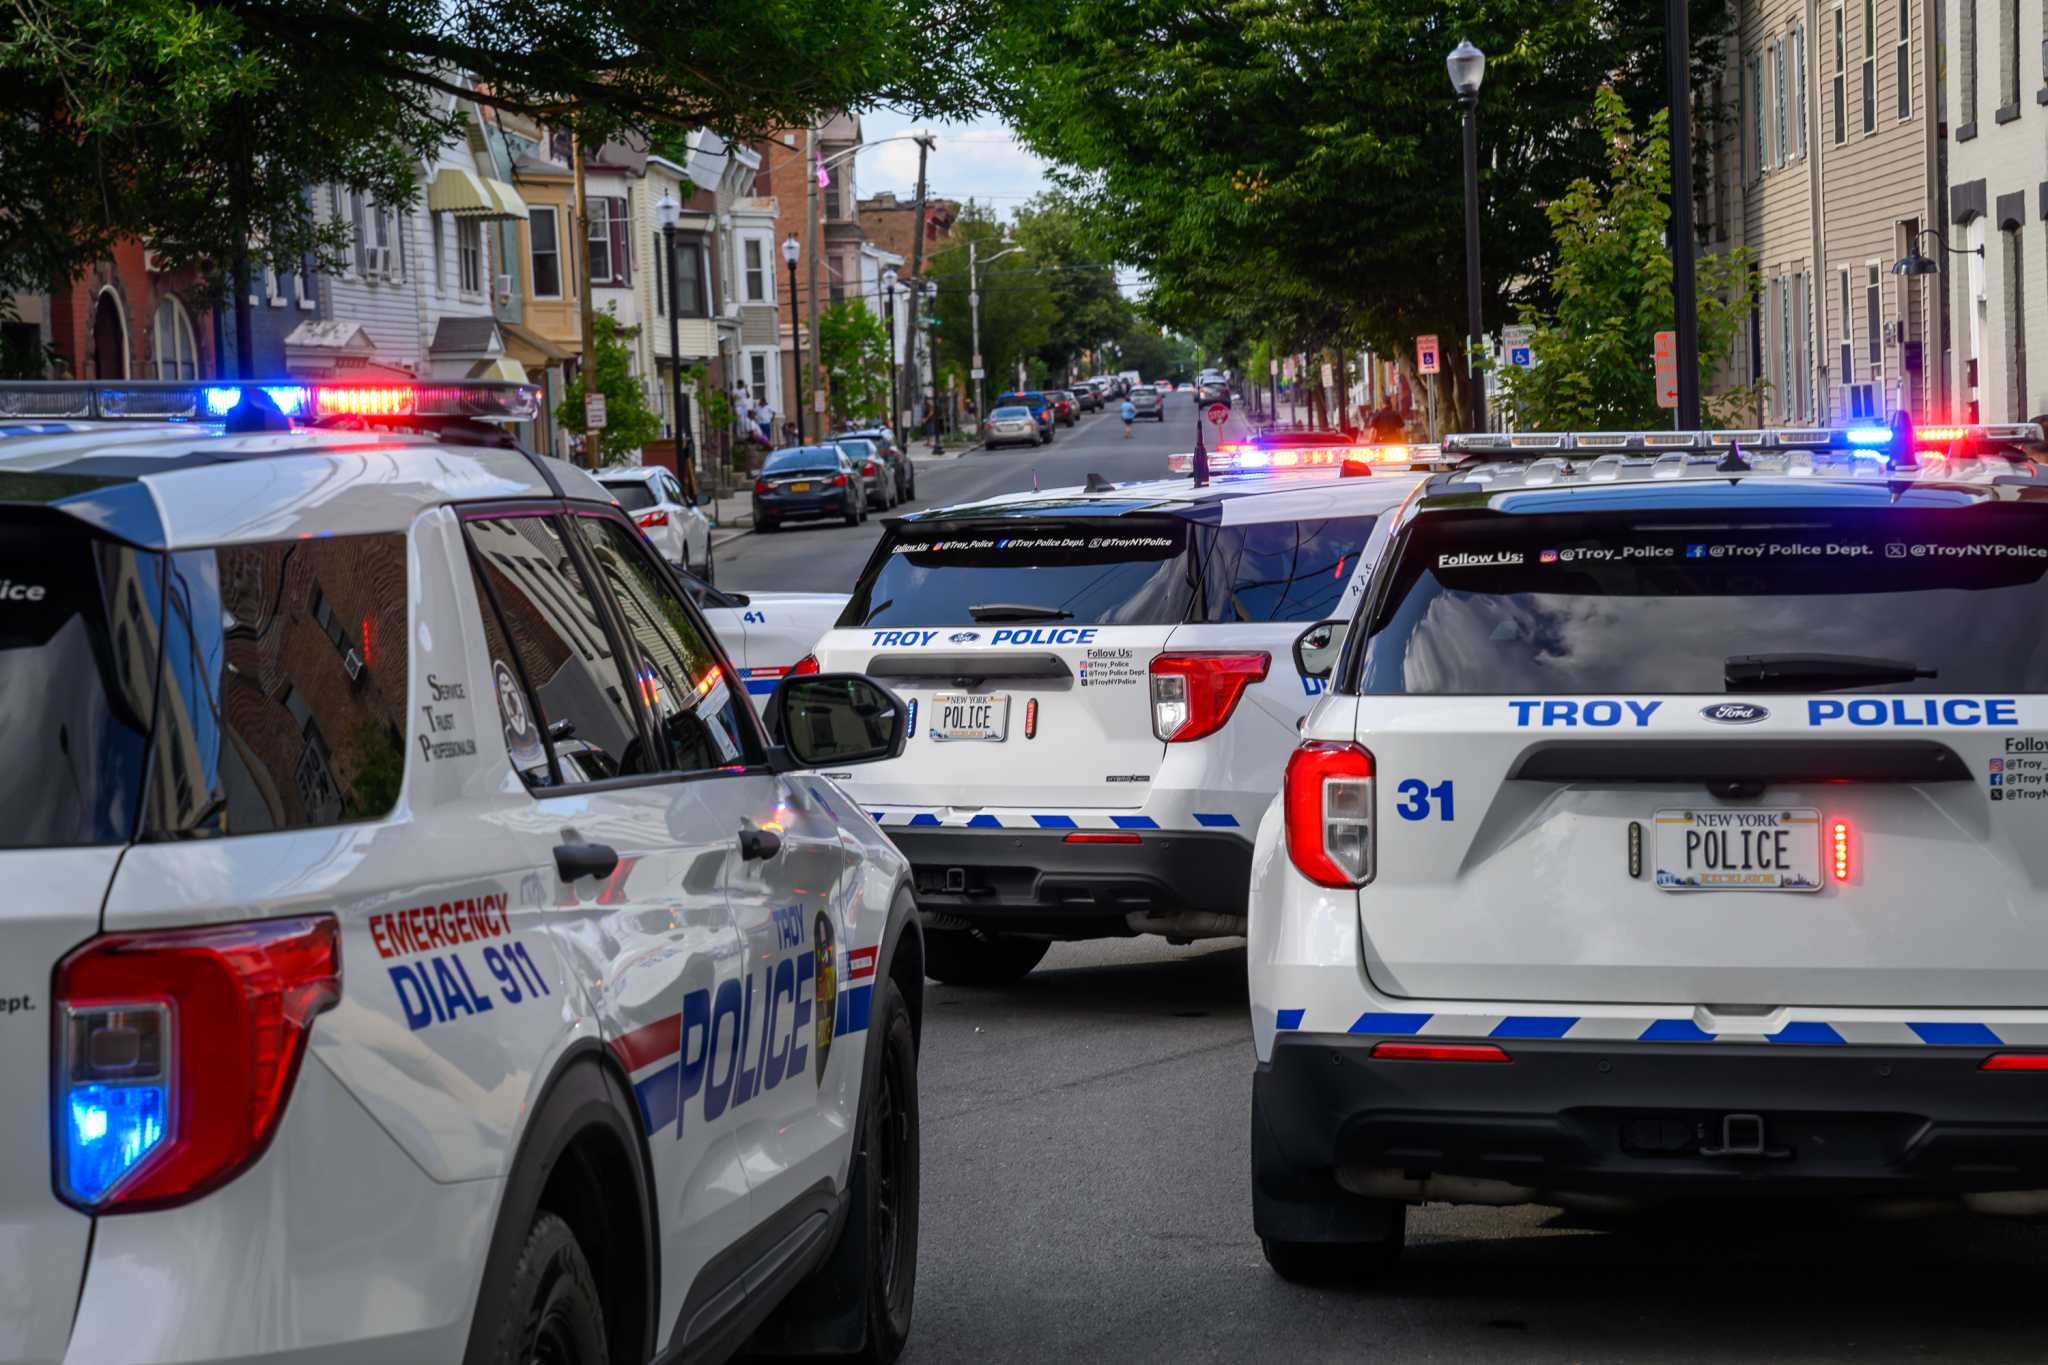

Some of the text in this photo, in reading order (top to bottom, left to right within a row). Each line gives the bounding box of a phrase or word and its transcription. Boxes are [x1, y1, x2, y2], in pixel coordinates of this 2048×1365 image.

[942, 540, 994, 550] @Troy_Police
[1007, 538, 1085, 548] @Troy Police Dept.
[1101, 538, 1173, 547] @TroyNYPolice
[1709, 543, 1873, 558] @Troy Police Dept.
[1911, 544, 2048, 558] @TroyNYPolice
[1438, 551, 1524, 568] Follow Us:
[1559, 546, 1674, 561] @Troy_Police
[0, 579, 46, 600] ice
[743, 611, 765, 624] 41
[871, 631, 939, 646] TROY
[991, 629, 1098, 645] POLICE
[1087, 648, 1133, 659] Follow Us:
[951, 696, 988, 704] NEW YORK
[943, 705, 992, 729] POLICE
[1509, 700, 1664, 727] TROY
[1808, 699, 2018, 726] POLICE
[2005, 737, 2048, 754] Follo
[1396, 778, 1454, 821] 31
[1695, 813, 1779, 827] NEW YORK
[1686, 830, 1791, 869] POLICE
[368, 893, 511, 960] EMERGENCY
[772, 903, 805, 950] TROY
[387, 941, 551, 1032] DIAL 911
[676, 950, 815, 1142] POLICE
